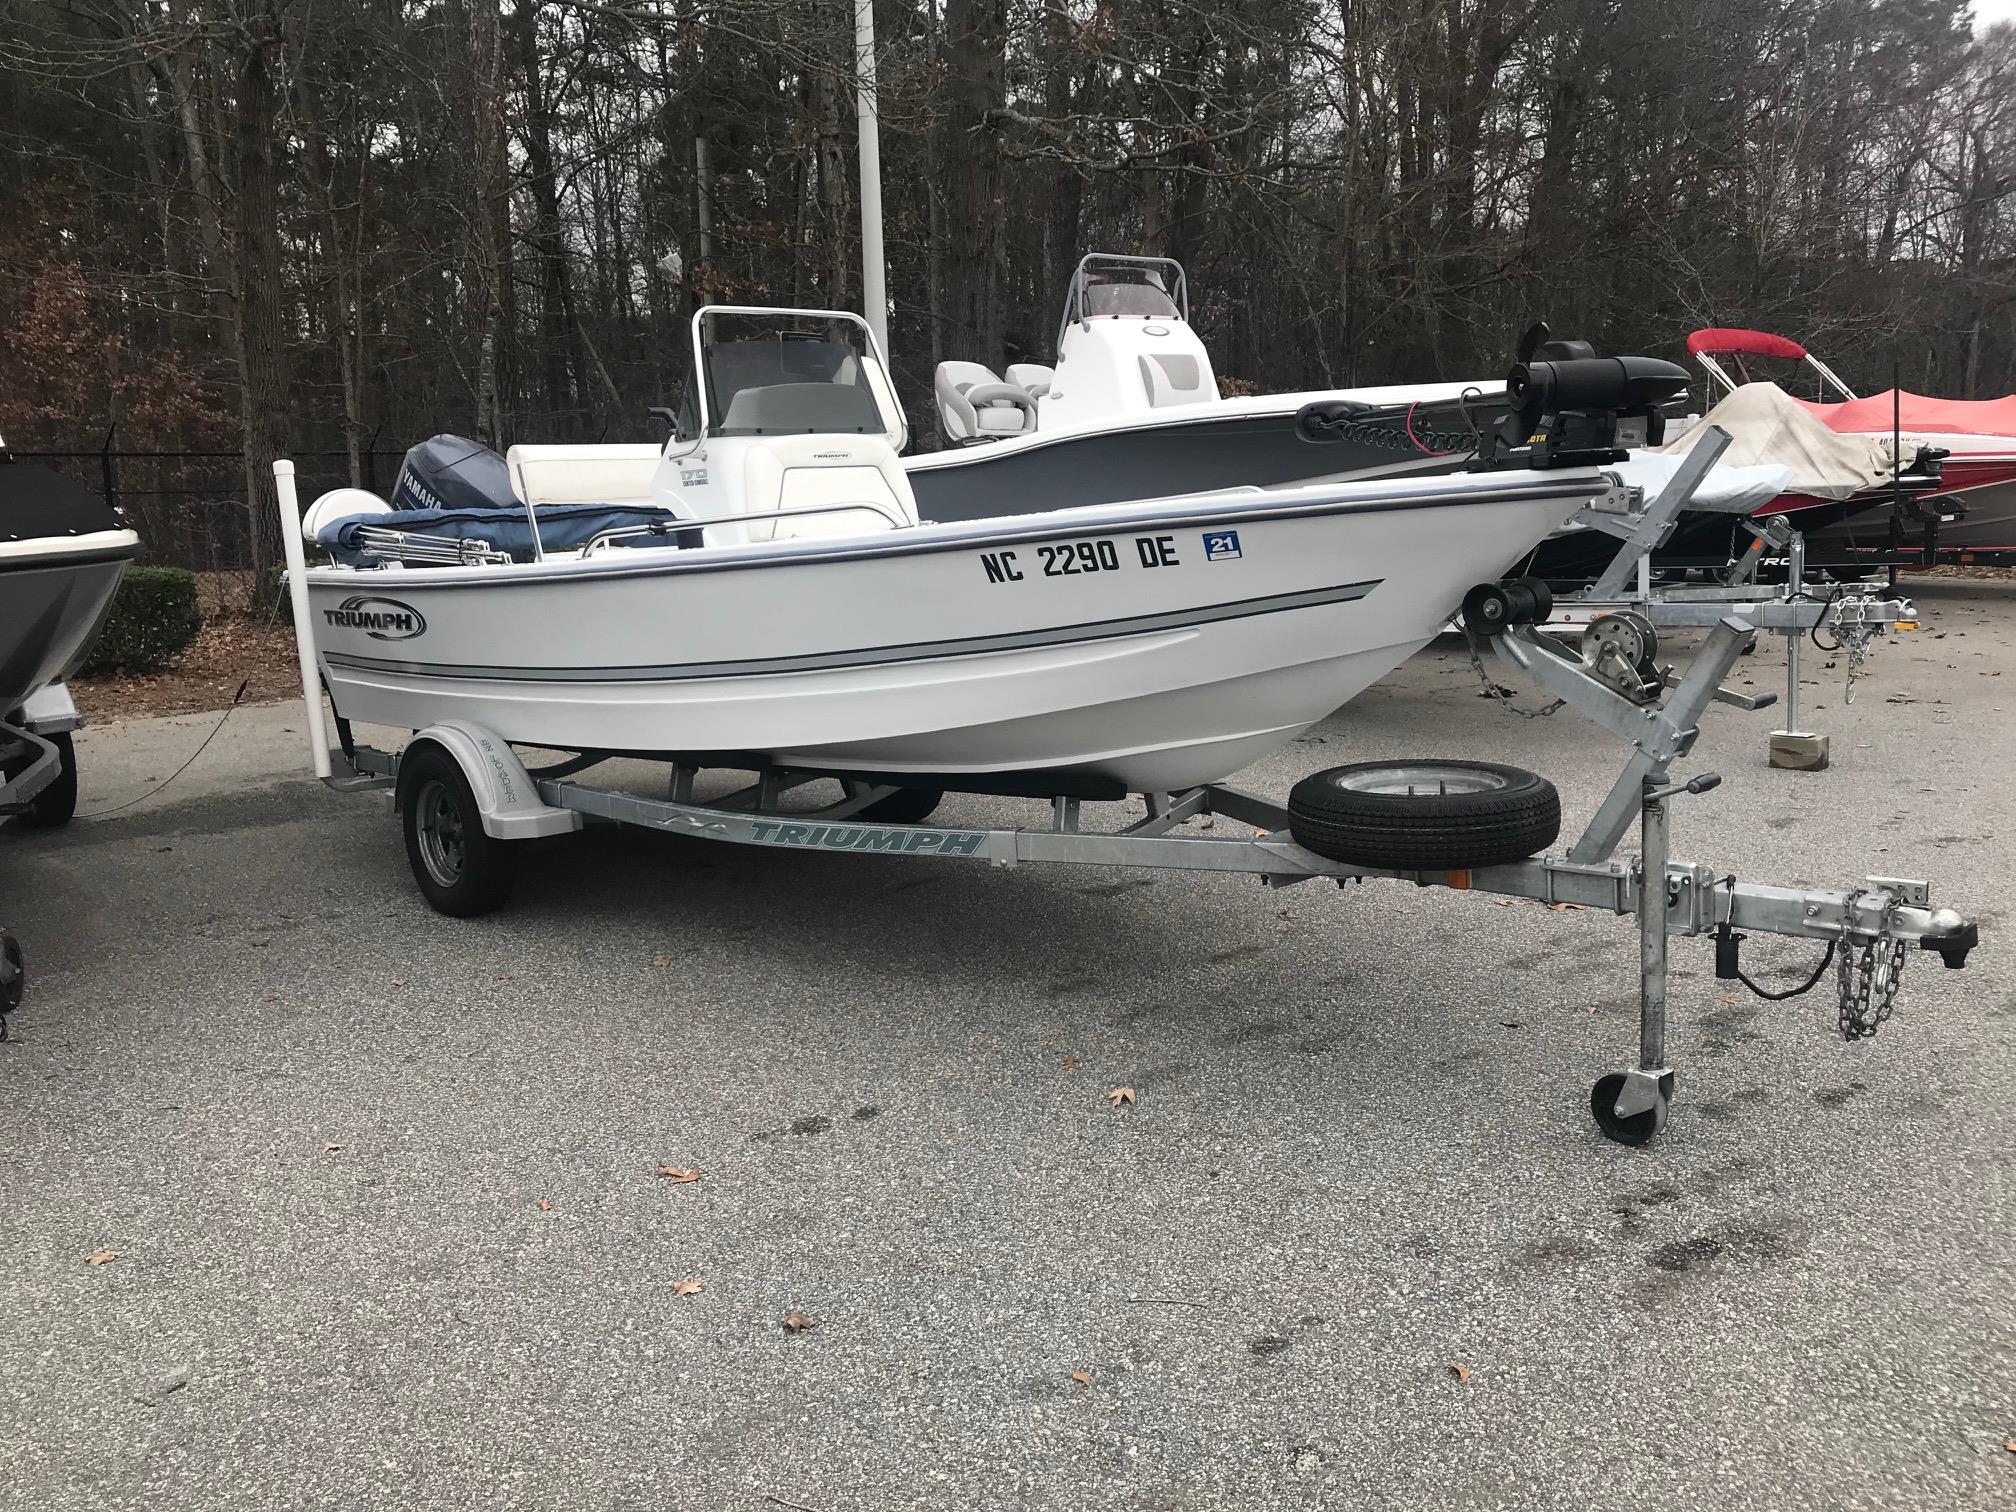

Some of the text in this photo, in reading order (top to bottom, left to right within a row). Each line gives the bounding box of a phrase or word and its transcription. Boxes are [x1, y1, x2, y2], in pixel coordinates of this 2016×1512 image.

[403, 468, 442, 509] YAMAHA
[981, 535, 1180, 584] NC 2290 DE
[1210, 536, 1234, 551] 21
[323, 609, 413, 631] TRIUMPH
[750, 822, 987, 855] TRIUMPH
